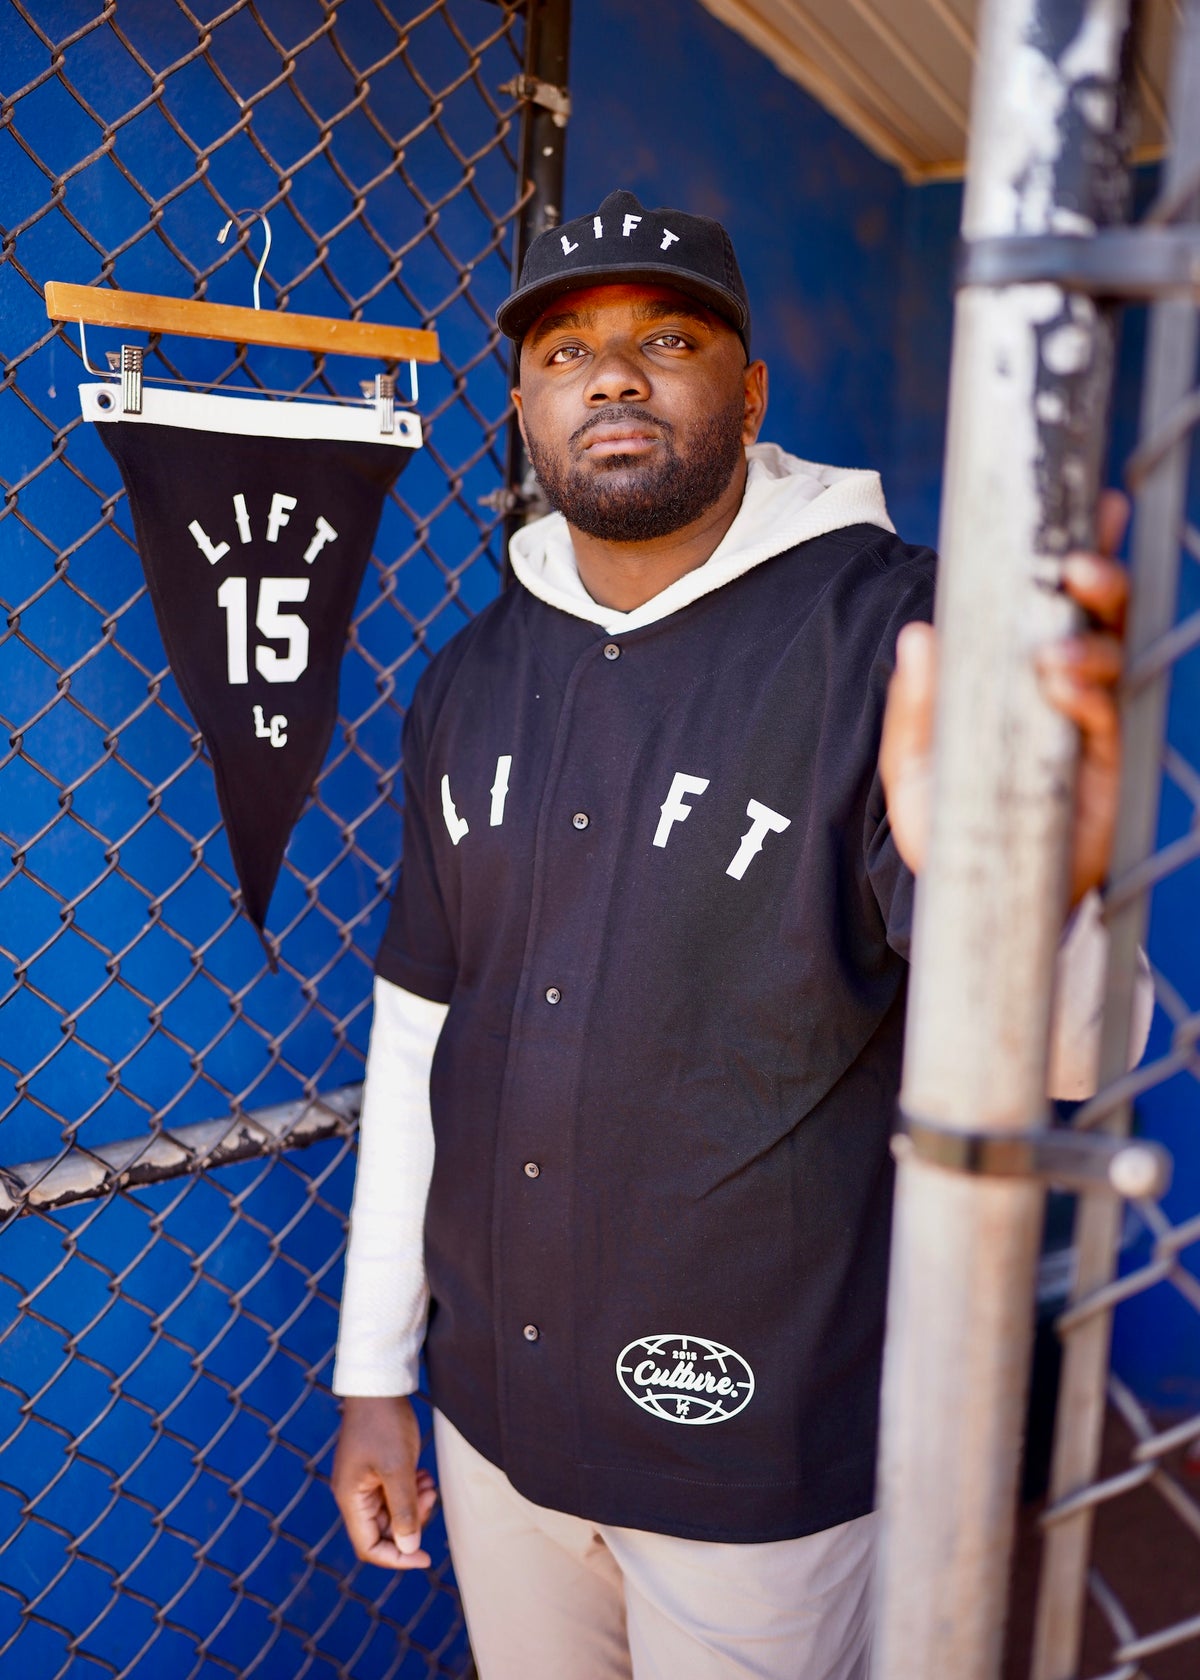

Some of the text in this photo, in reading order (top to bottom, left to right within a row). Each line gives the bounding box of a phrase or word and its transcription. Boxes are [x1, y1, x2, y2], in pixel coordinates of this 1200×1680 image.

[560, 213, 680, 256] LIFT
[188, 492, 338, 565] LIFT
[217, 577, 310, 684] 15
[252, 704, 288, 748] LC
